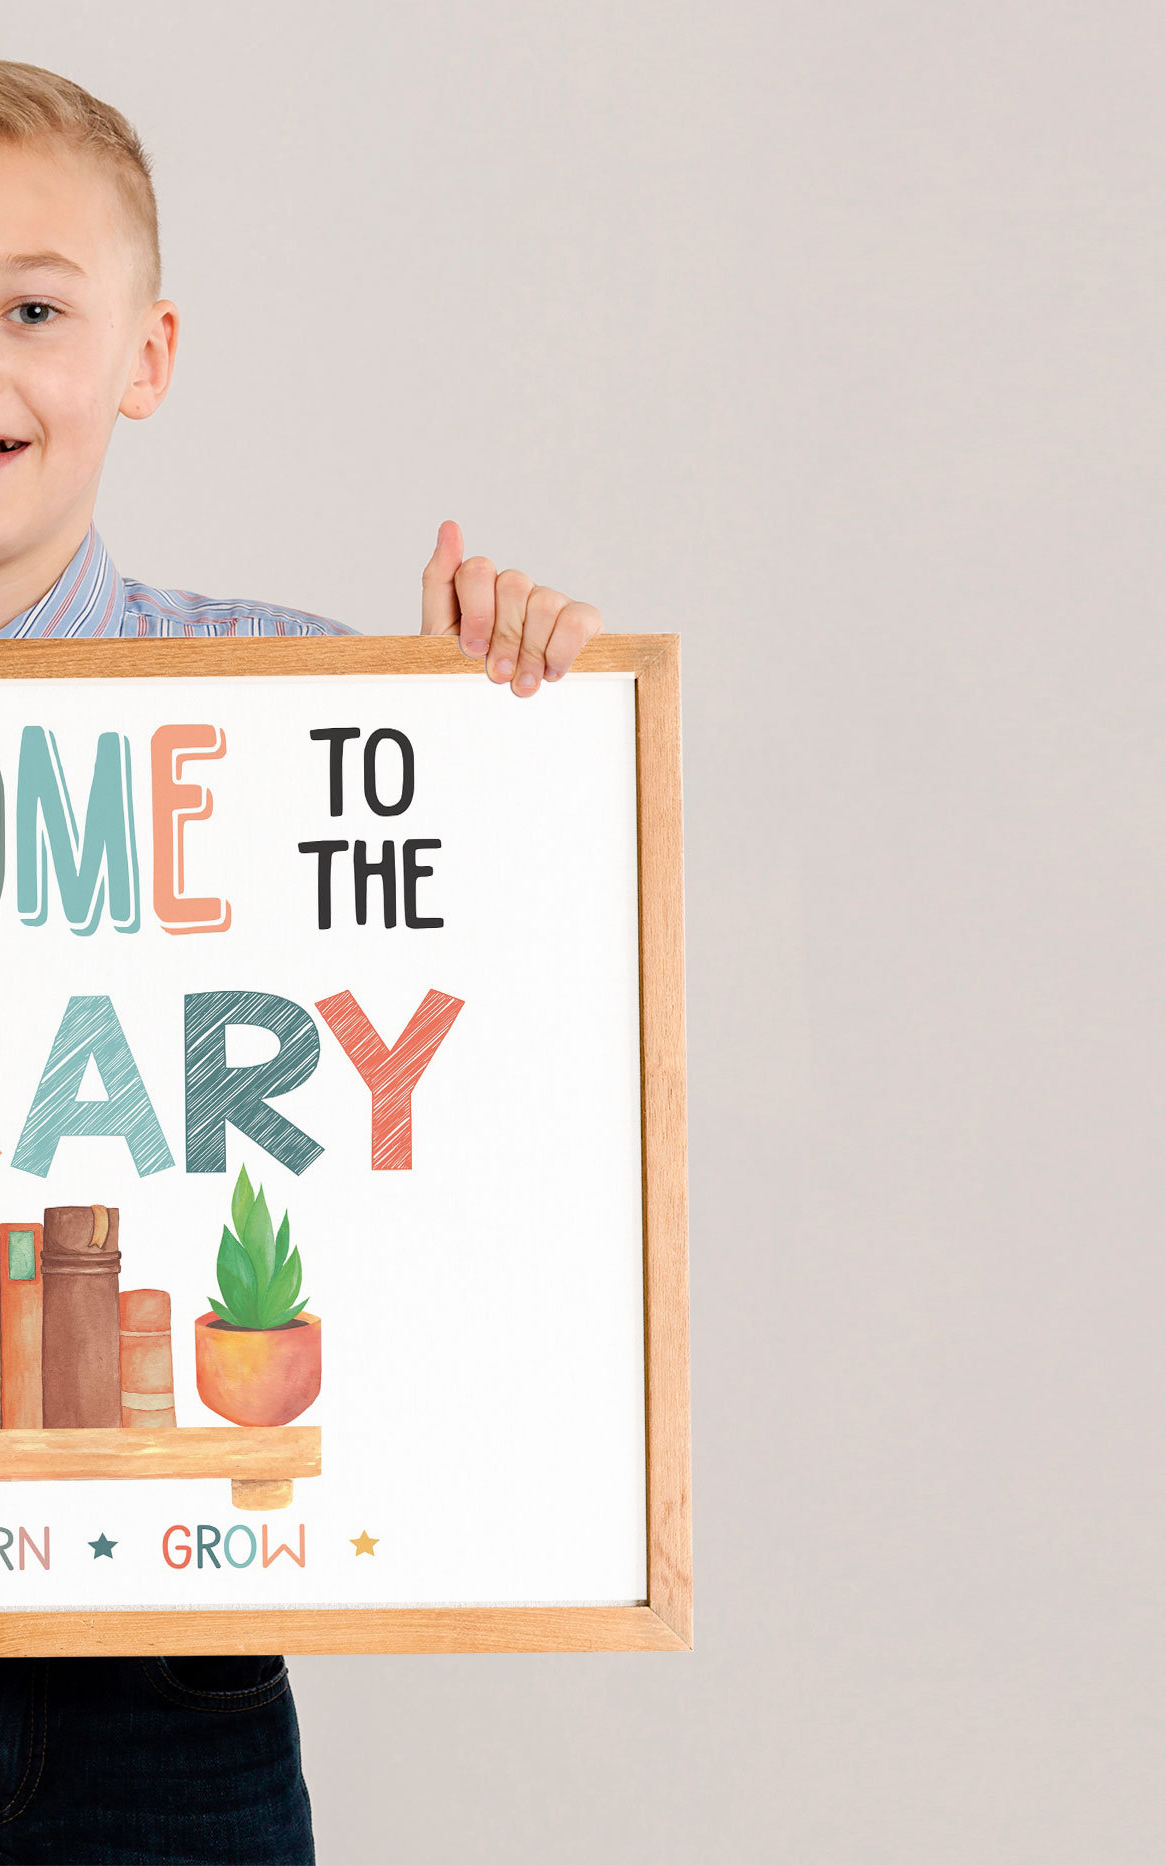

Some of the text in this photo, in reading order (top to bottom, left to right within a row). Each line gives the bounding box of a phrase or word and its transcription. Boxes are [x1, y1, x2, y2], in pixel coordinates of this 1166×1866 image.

[310, 727, 414, 817] TO
[298, 839, 444, 930] THE
[162, 1524, 306, 1570] GROW
